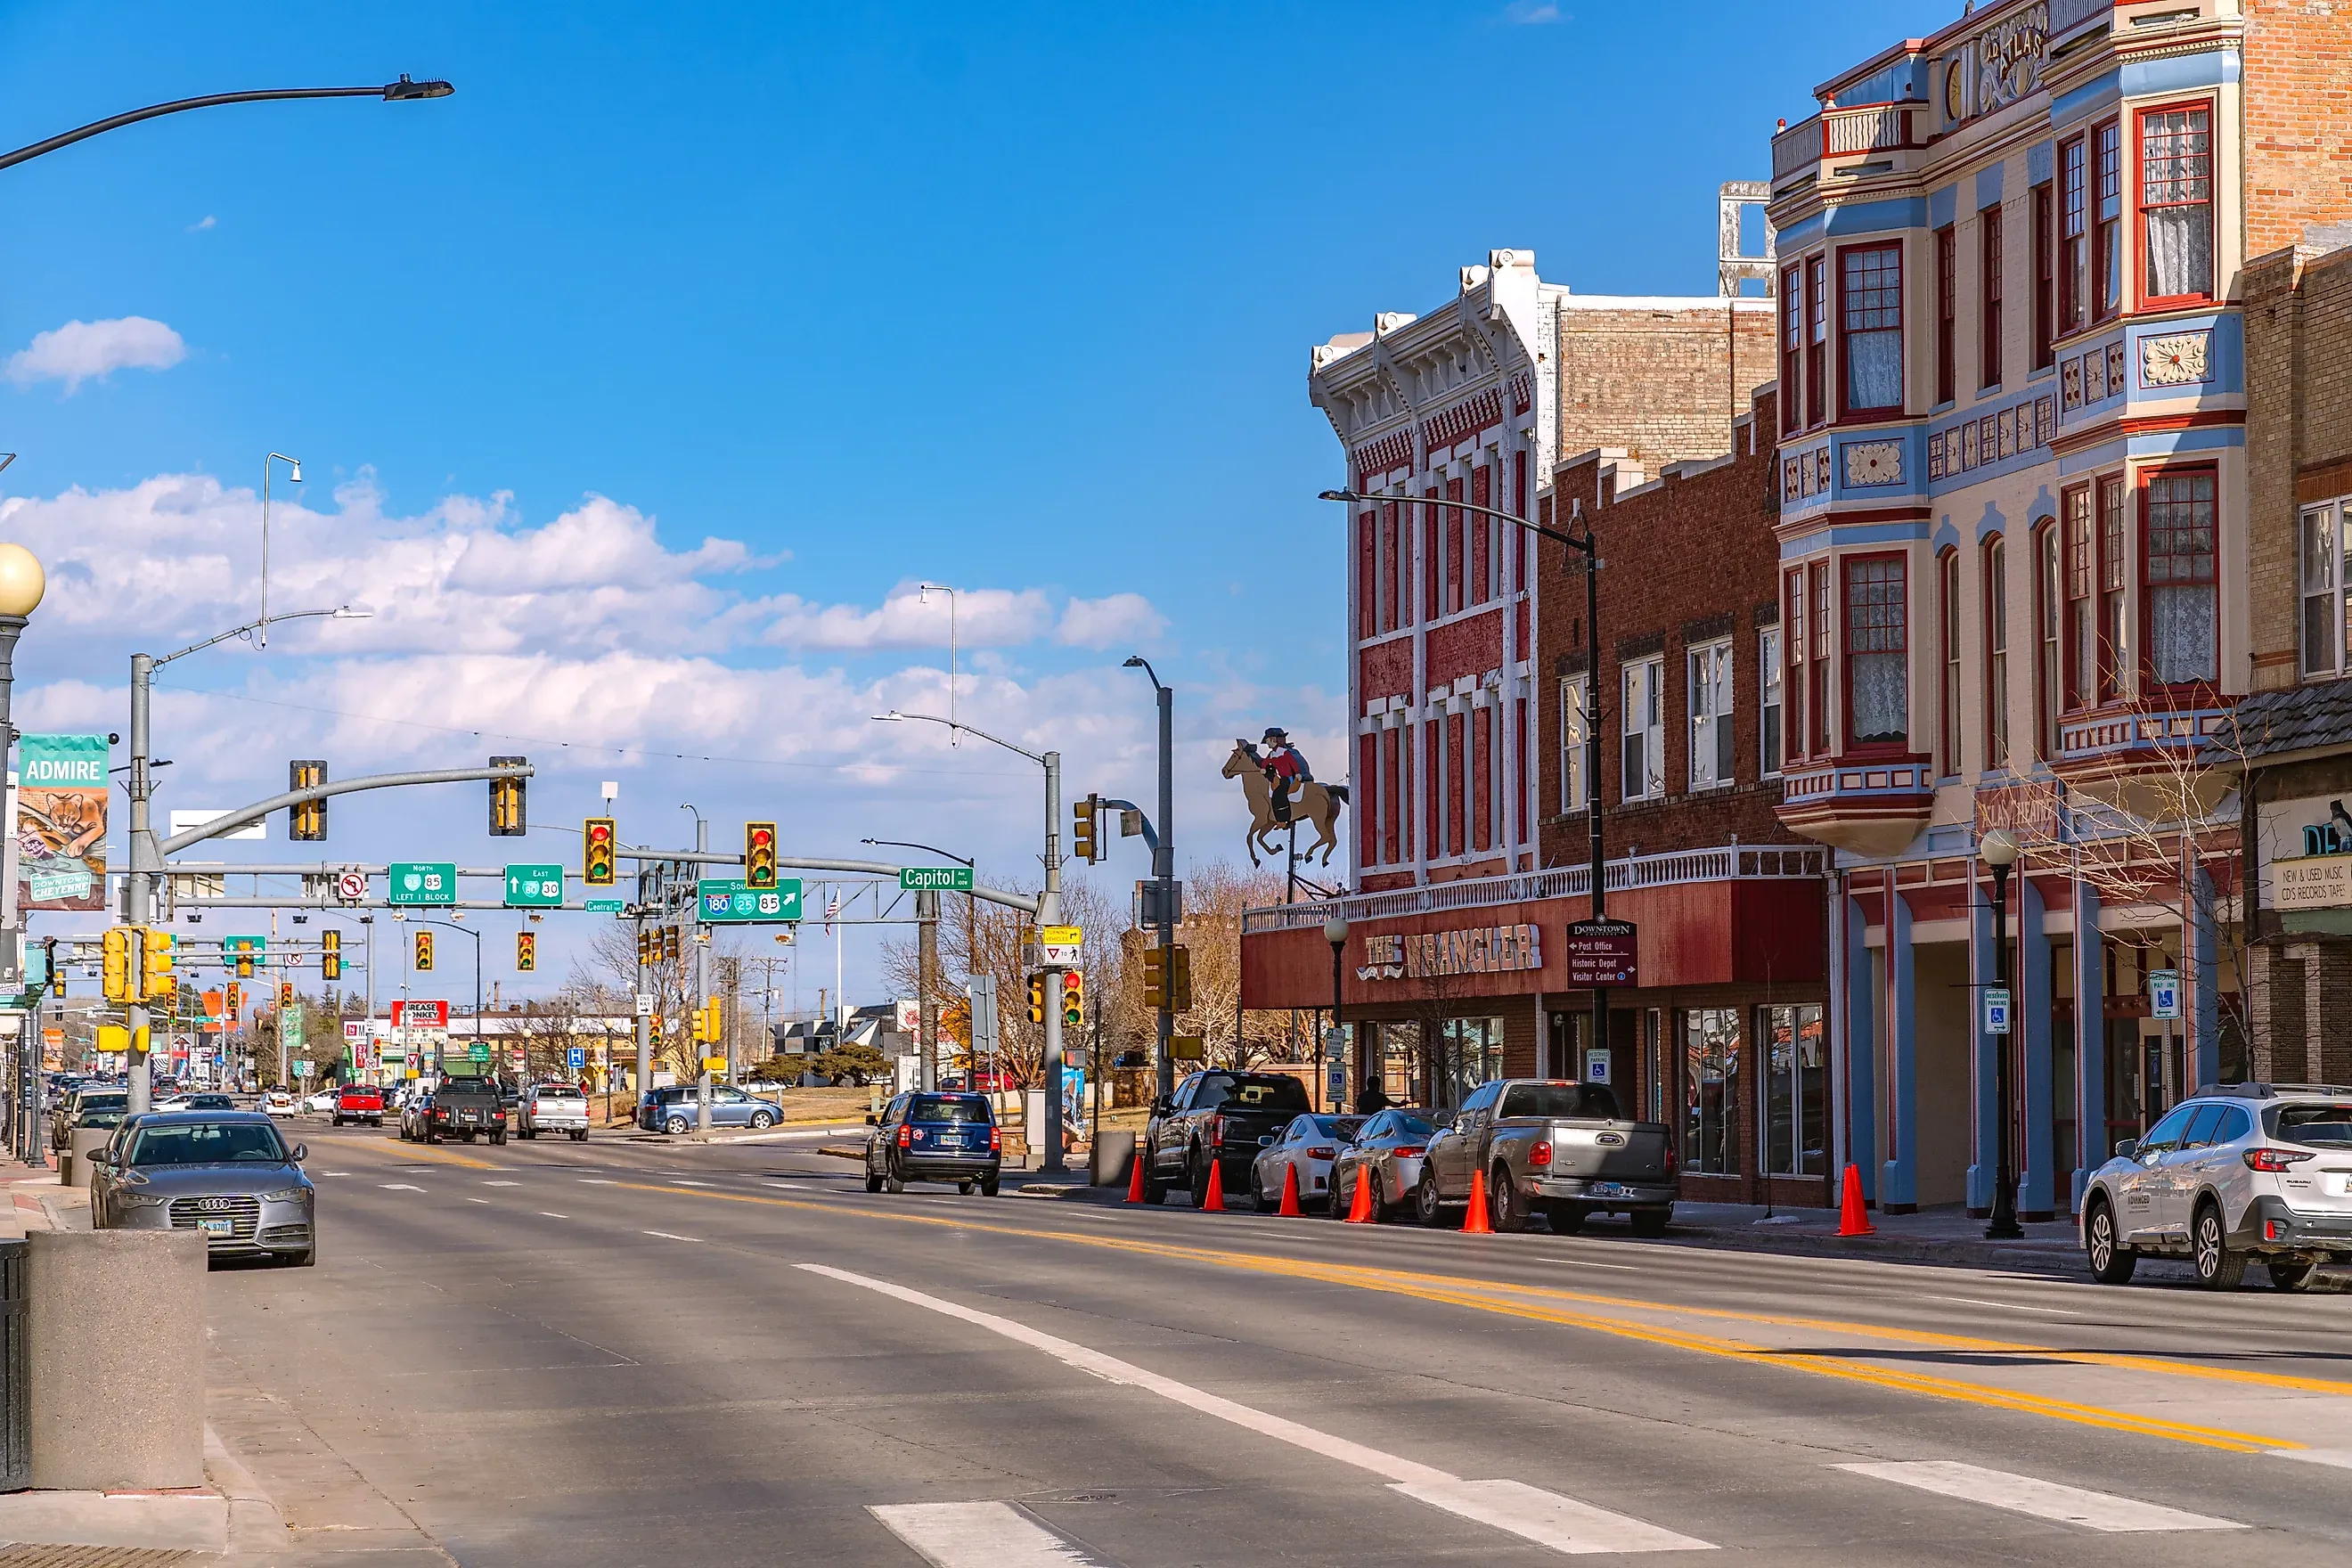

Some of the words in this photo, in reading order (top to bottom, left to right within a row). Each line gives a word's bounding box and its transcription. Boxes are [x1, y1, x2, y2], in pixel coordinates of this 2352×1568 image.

[2000, 29, 2042, 79] ATLAS
[26, 760, 101, 780] ADMIRE
[533, 870, 549, 878] EAST
[905, 869, 955, 889] Capitol
[2283, 870, 2298, 884] NEW
[2299, 869, 2305, 883] &
[2306, 868, 2323, 882] USED
[2324, 865, 2344, 880] MUSIC
[34, 875, 89, 889] DOWNTOWN
[426, 878, 440, 887] 85
[34, 881, 88, 899] CHEYENNE
[543, 884, 558, 894] 30
[2298, 885, 2327, 900] RECORDS
[587, 901, 613, 911] Central
[708, 898, 729, 911] 180
[738, 901, 753, 911] 25
[761, 897, 778, 909] 85
[1573, 926, 1630, 935] DOWNTOWN
[1365, 935, 1402, 965] THE
[1404, 924, 1542, 978] WRANGLER
[1578, 941, 1592, 951] Post
[1594, 941, 1613, 951] Office
[1572, 958, 1597, 968] Historic
[1598, 958, 1617, 969] Depot
[1572, 971, 1593, 982] Visitor
[1596, 971, 1616, 981] Center
[571, 1049, 582, 1061] H
[212, 1223, 229, 1231] 9701
